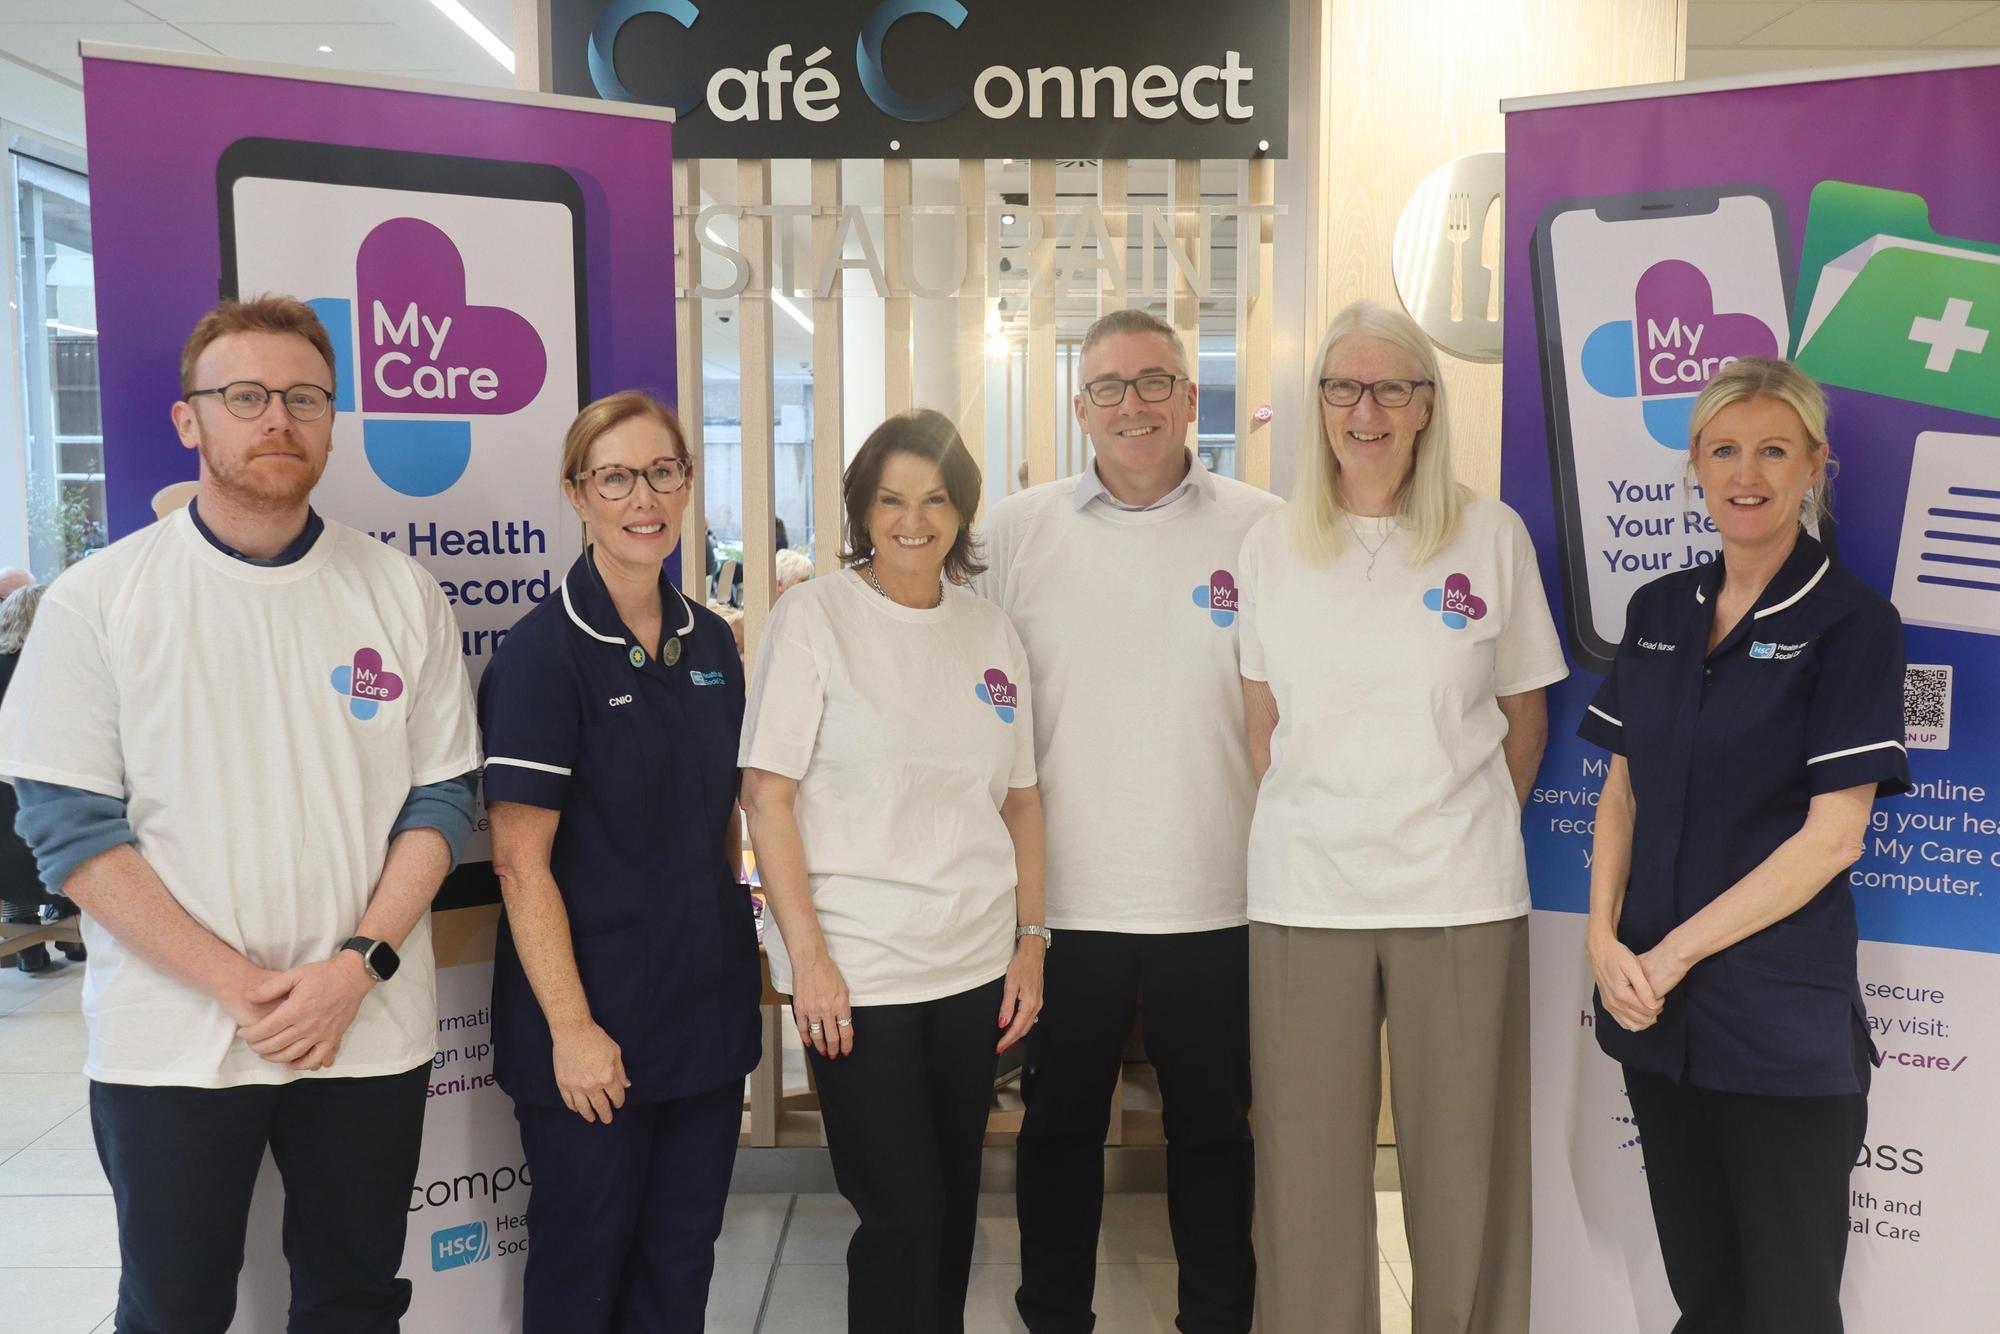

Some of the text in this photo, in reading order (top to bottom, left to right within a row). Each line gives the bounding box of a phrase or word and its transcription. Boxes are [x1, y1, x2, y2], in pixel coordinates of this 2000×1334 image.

[588, 0, 1255, 124] Café Connect
[373, 300, 452, 361] My
[1647, 316, 1704, 356] My
[374, 351, 499, 401] Care
[1607, 480, 1675, 503] Your
[1606, 515, 1675, 538] Your
[408, 520, 546, 556] Health
[1602, 549, 1672, 573] Your
[1212, 585, 1231, 600] My
[1447, 588, 1467, 603] My
[1446, 599, 1475, 616] Care
[1637, 637, 1657, 650] Lead
[356, 667, 378, 685] My
[355, 681, 389, 698] Care
[990, 683, 1008, 695] My
[993, 693, 1017, 705] Care
[609, 694, 633, 707] CNIO
[1920, 734, 1937, 743] UP
[1896, 812, 1956, 834] your
[1875, 837, 1914, 865] My
[1920, 841, 1983, 865] Care
[1849, 871, 1983, 897] computer.
[1865, 983, 1945, 1004] secure
[1899, 1016, 1949, 1038] visit:
[465, 1043, 490, 1062] up
[1884, 1200, 1922, 1217] and
[1876, 1221, 1921, 1242] Care
[439, 1234, 478, 1258] HSC
[498, 1238, 528, 1257] Soc
